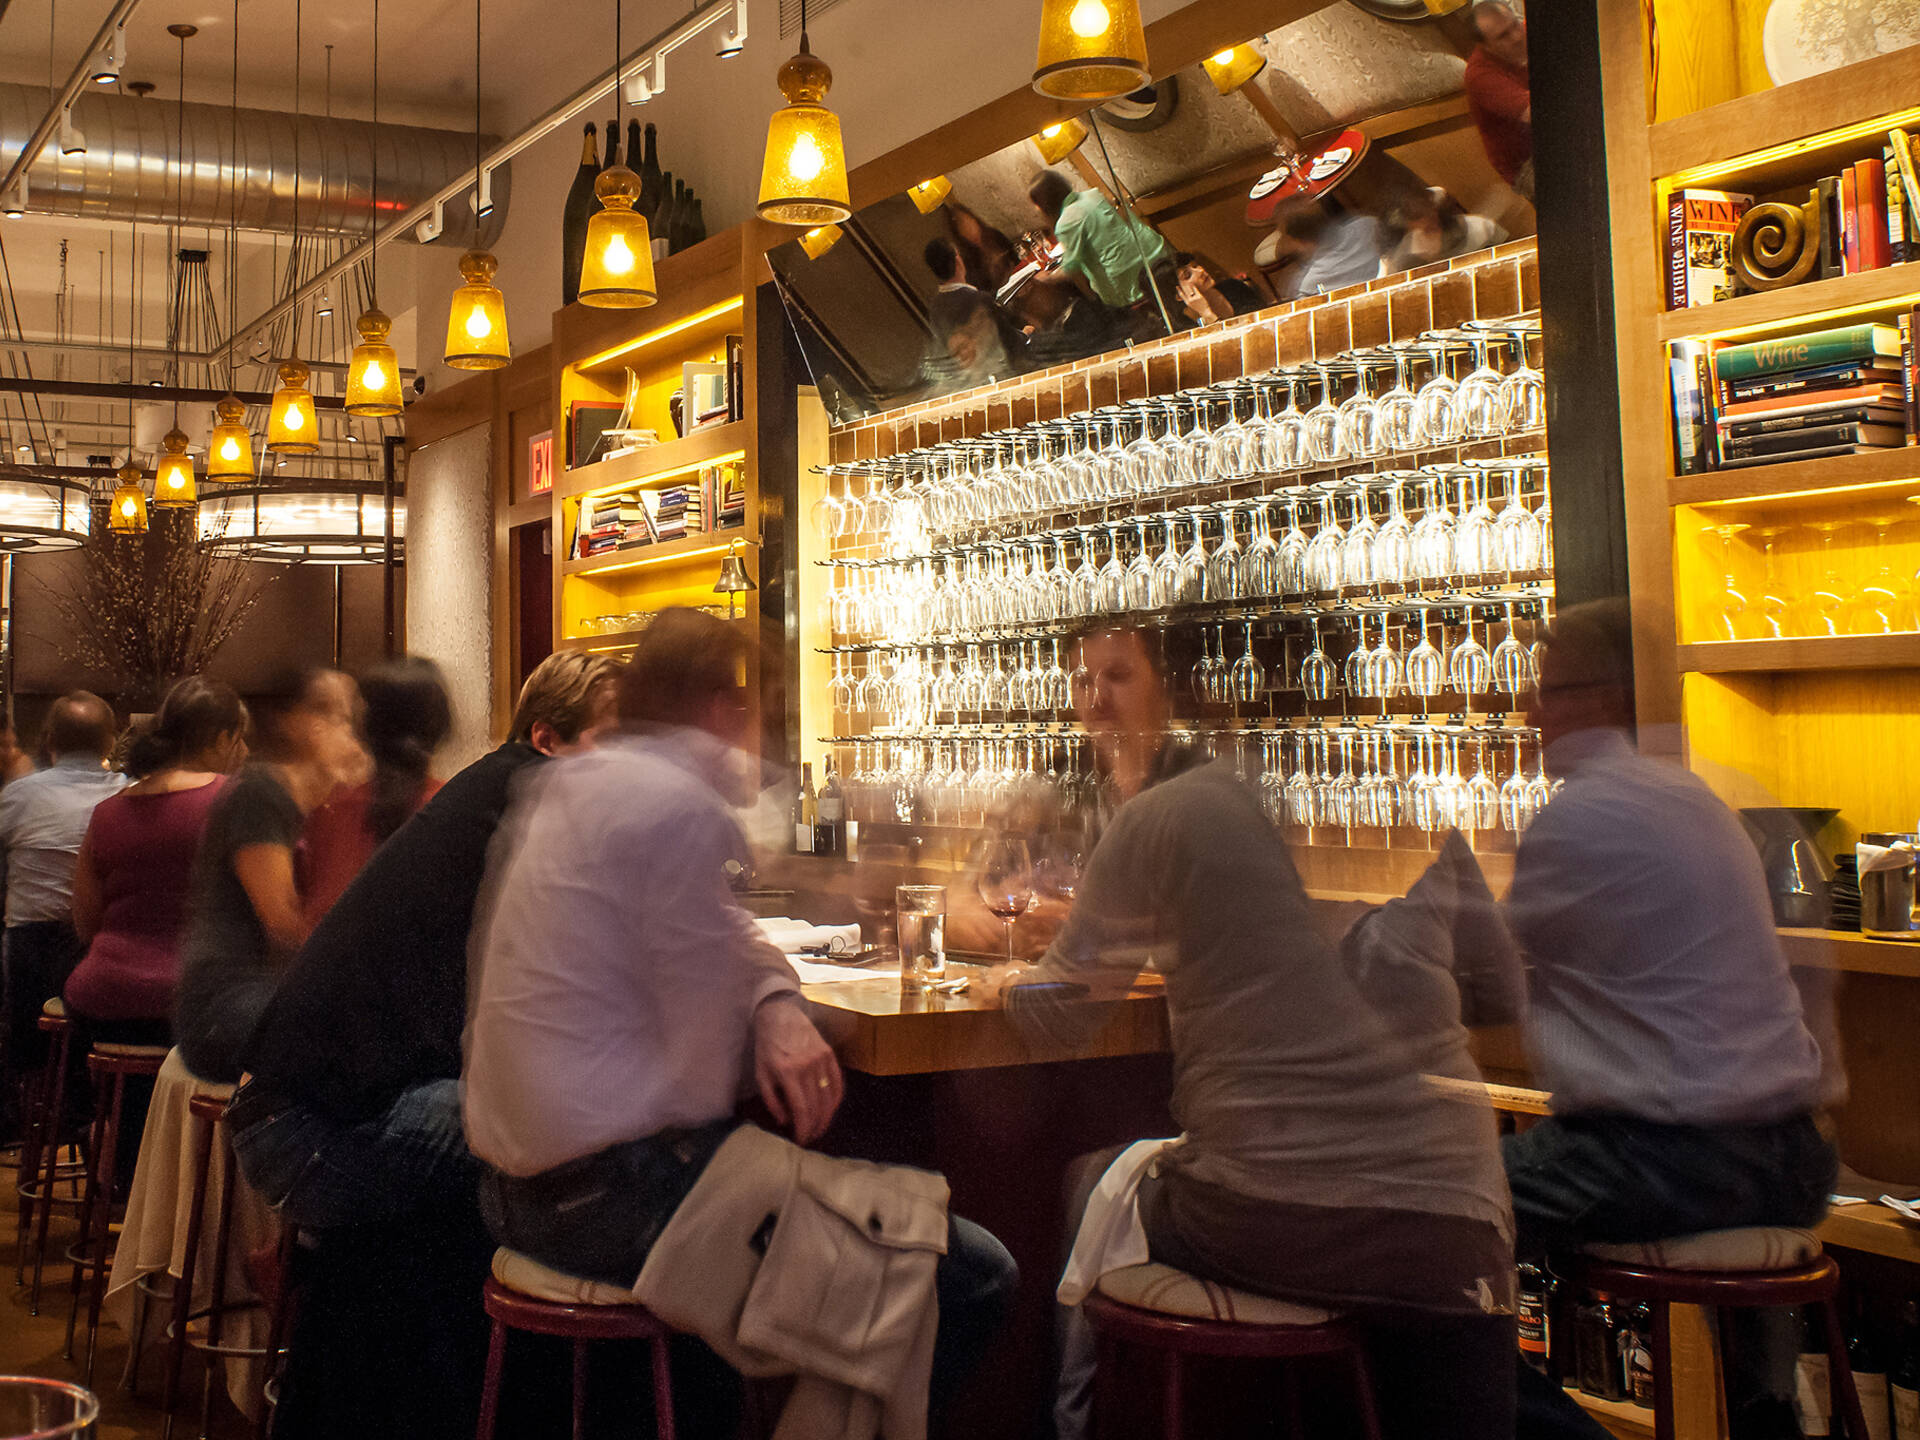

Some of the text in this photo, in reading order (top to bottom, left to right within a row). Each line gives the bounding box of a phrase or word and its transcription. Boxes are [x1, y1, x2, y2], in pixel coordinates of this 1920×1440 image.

[1670, 203, 1687, 306] WINE BIBLE
[1752, 340, 1809, 368] Wine
[532, 438, 552, 492] EXI
